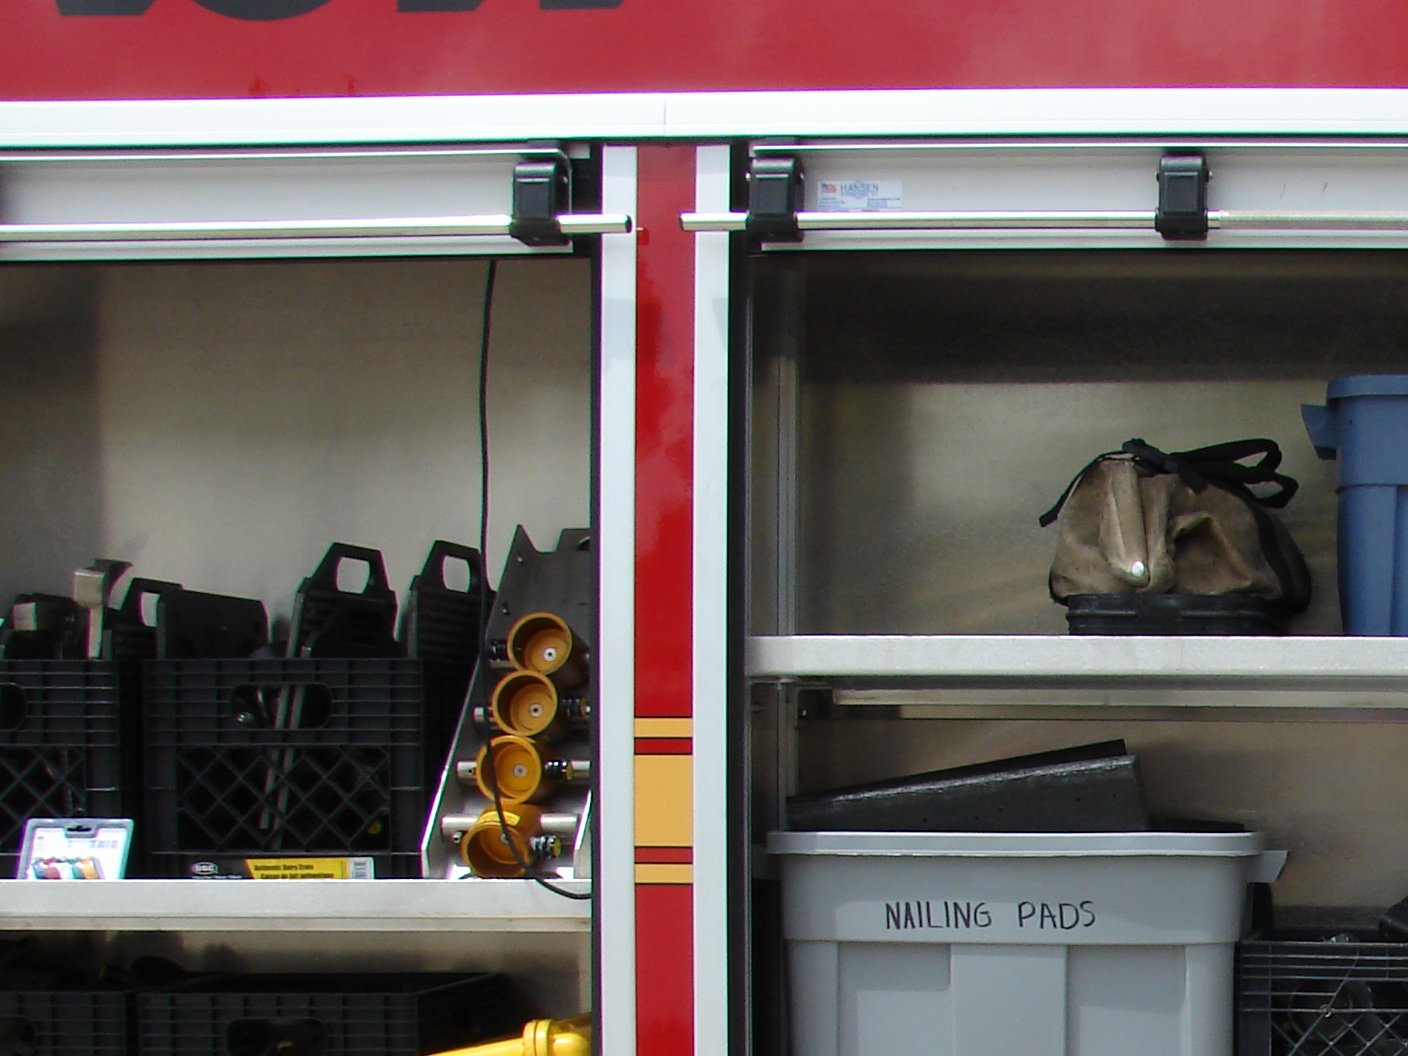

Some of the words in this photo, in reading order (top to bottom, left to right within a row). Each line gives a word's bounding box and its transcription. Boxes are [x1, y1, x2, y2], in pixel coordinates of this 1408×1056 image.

[840, 183, 880, 193] HANSEN
[885, 900, 993, 930] NAILING
[1017, 900, 1097, 930] PADS
